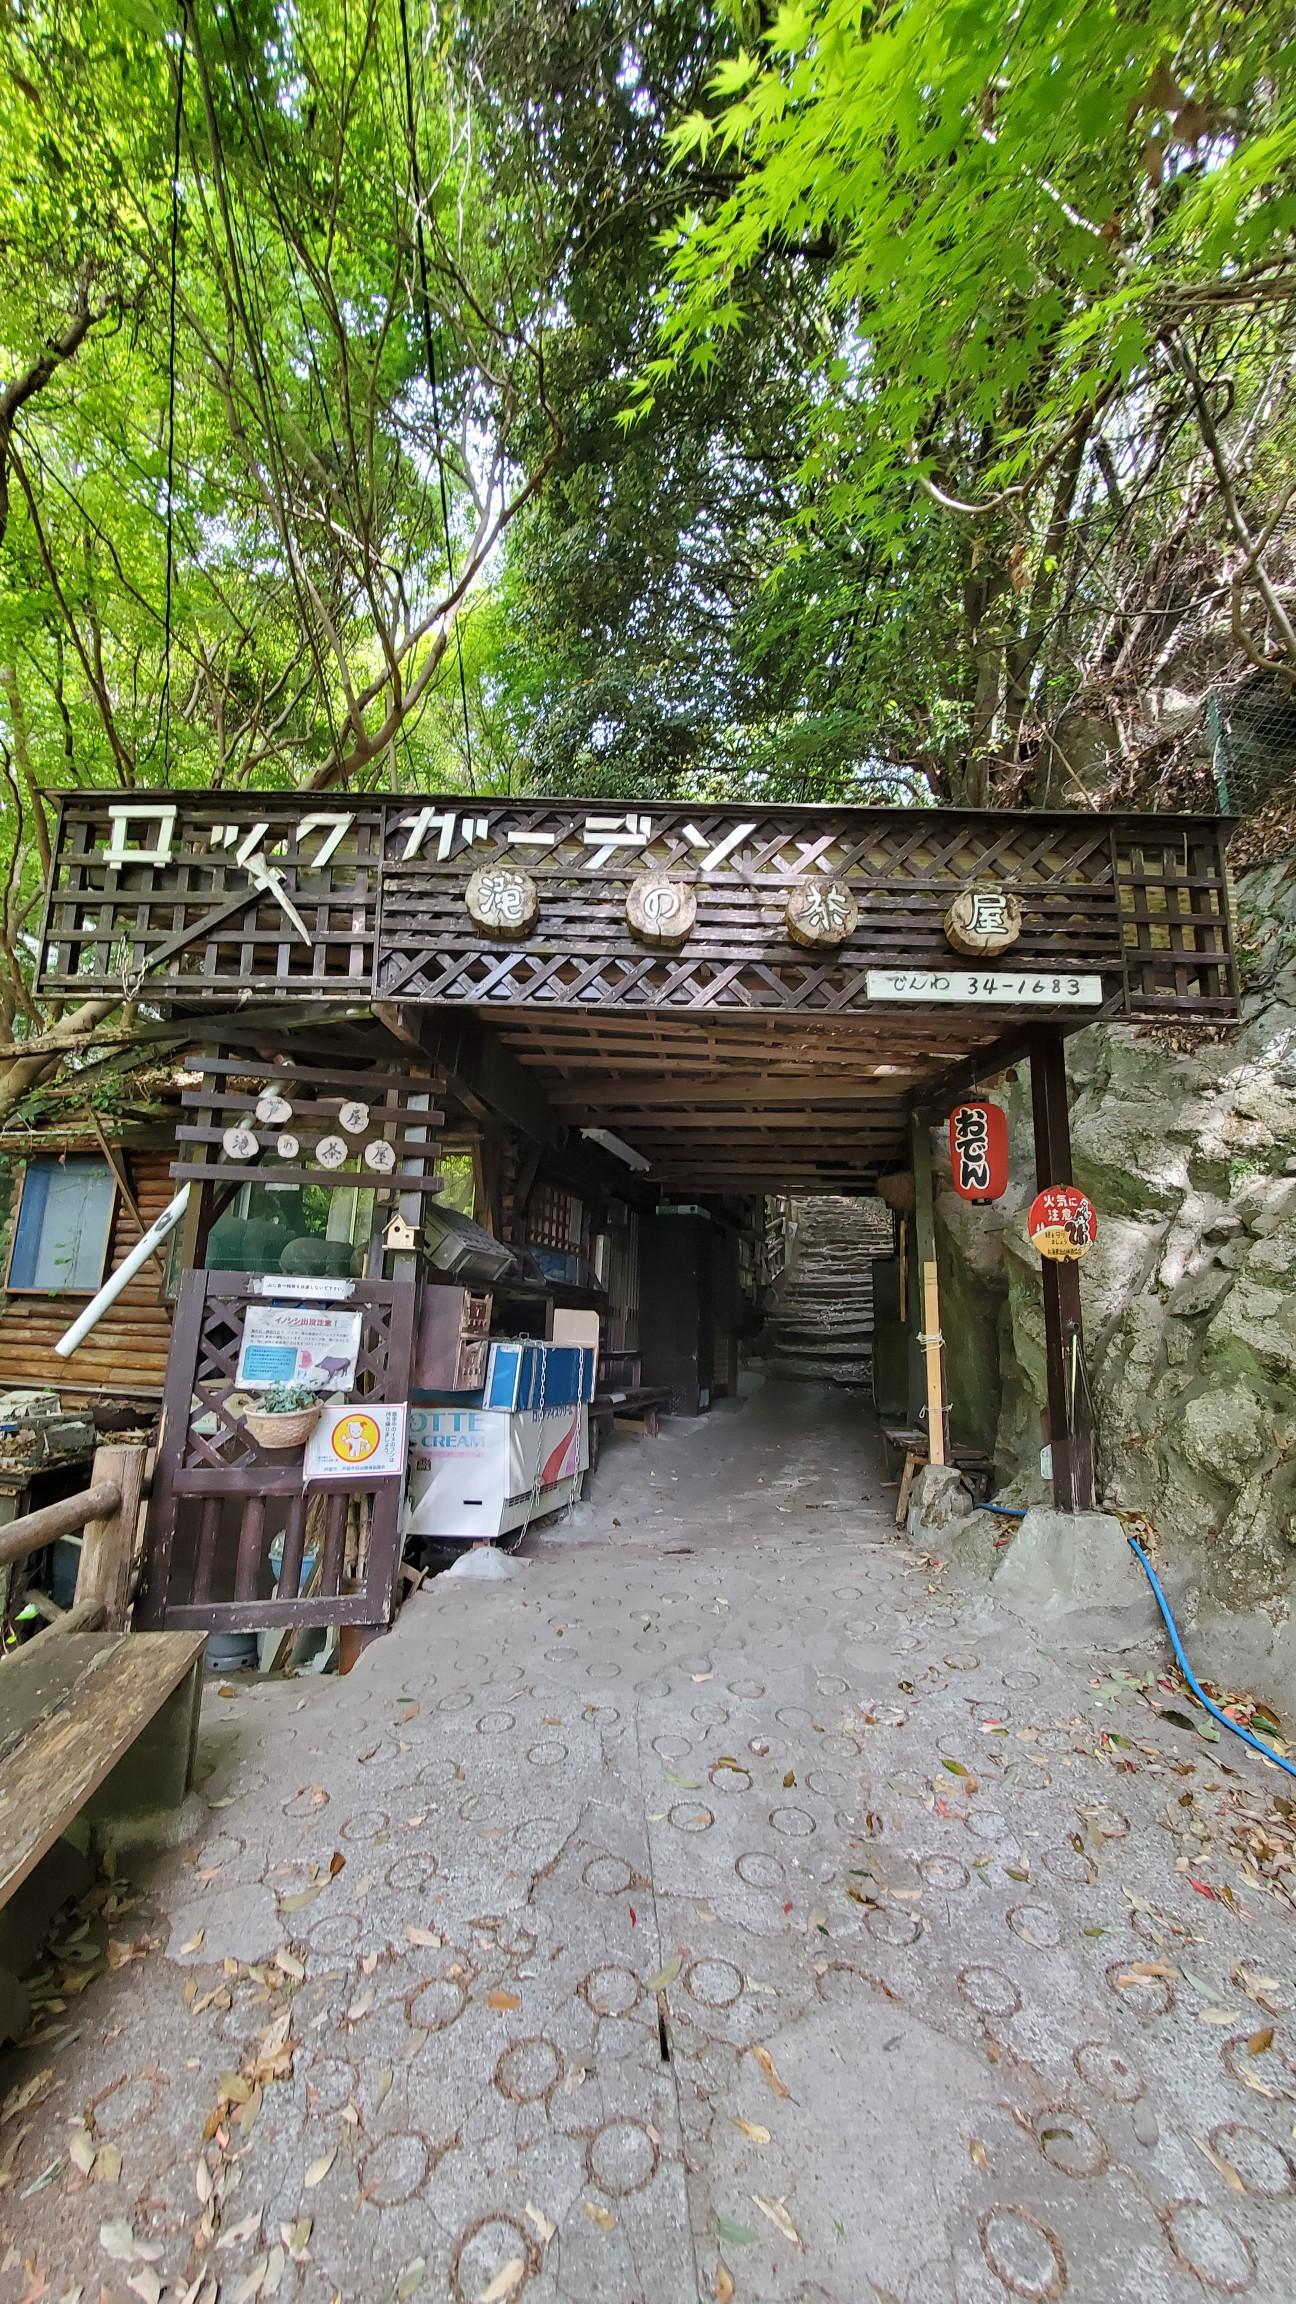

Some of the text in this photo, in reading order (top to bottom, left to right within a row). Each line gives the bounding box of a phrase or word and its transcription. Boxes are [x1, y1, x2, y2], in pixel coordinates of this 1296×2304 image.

[103, 804, 757, 872] ロックガーデン
[891, 974, 1081, 999] でんわ 34-1683
[956, 1108, 989, 1190] おでん
[1043, 1194, 1078, 1208] 火気に
[1048, 1208, 1073, 1221] 注意
[409, 1412, 486, 1432] OTTE
[421, 1435, 486, 1447] CREAM
